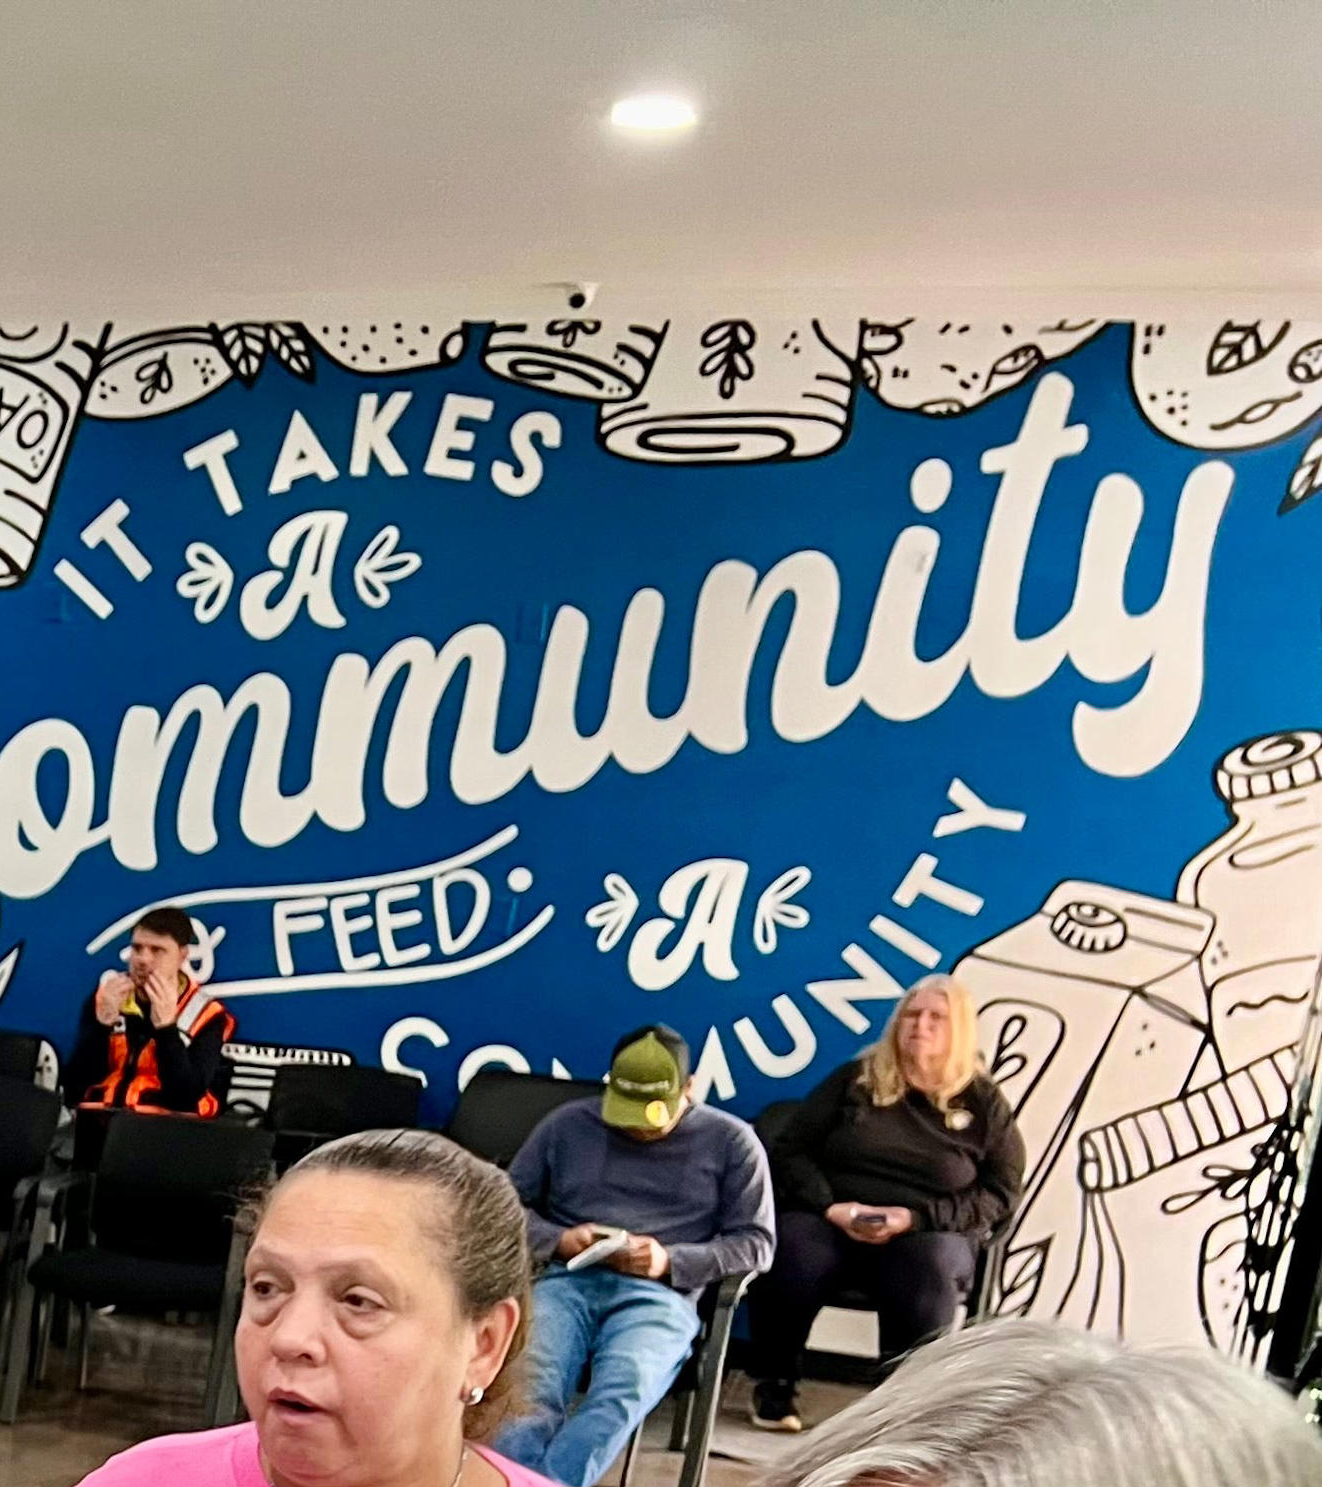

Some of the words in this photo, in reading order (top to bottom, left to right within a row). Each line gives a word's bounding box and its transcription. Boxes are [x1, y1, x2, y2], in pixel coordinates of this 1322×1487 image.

[54, 498, 153, 619] IT
[183, 391, 564, 517] TAKES
[240, 510, 348, 640] A
[274, 868, 490, 977] FEED
[628, 858, 749, 990] A
